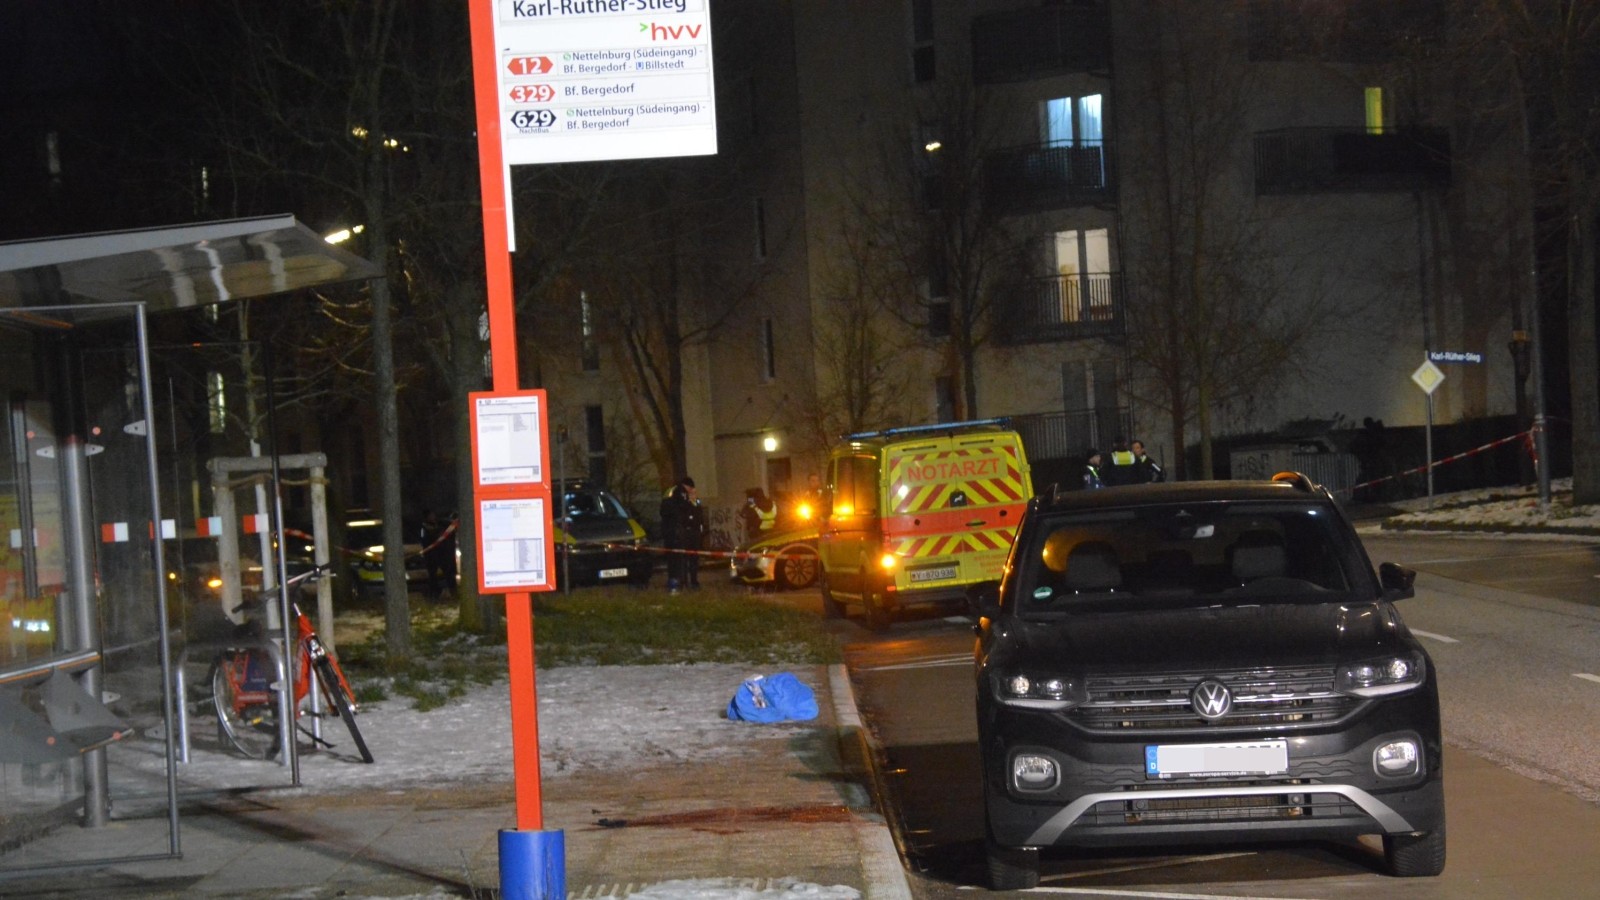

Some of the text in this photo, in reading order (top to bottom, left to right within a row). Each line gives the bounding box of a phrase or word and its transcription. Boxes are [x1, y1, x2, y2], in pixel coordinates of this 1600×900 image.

[651, 22, 702, 41] hvv
[573, 49, 631, 61] Nettelnburg
[633, 47, 697, 60] (Südeingang)
[518, 57, 543, 75] 12
[563, 63, 576, 74] Bf.
[579, 62, 627, 74] Bergedorf
[645, 60, 685, 70] Billstedt
[514, 84, 550, 103] 329
[564, 83, 635, 97] Bf. Bergedorf
[575, 106, 634, 118] Nettelnburg
[636, 103, 700, 116] (Südeingang)
[514, 110, 551, 128] 629
[566, 117, 629, 131] Bf. Bergedorf
[907, 458, 1000, 482] NOTARZT
